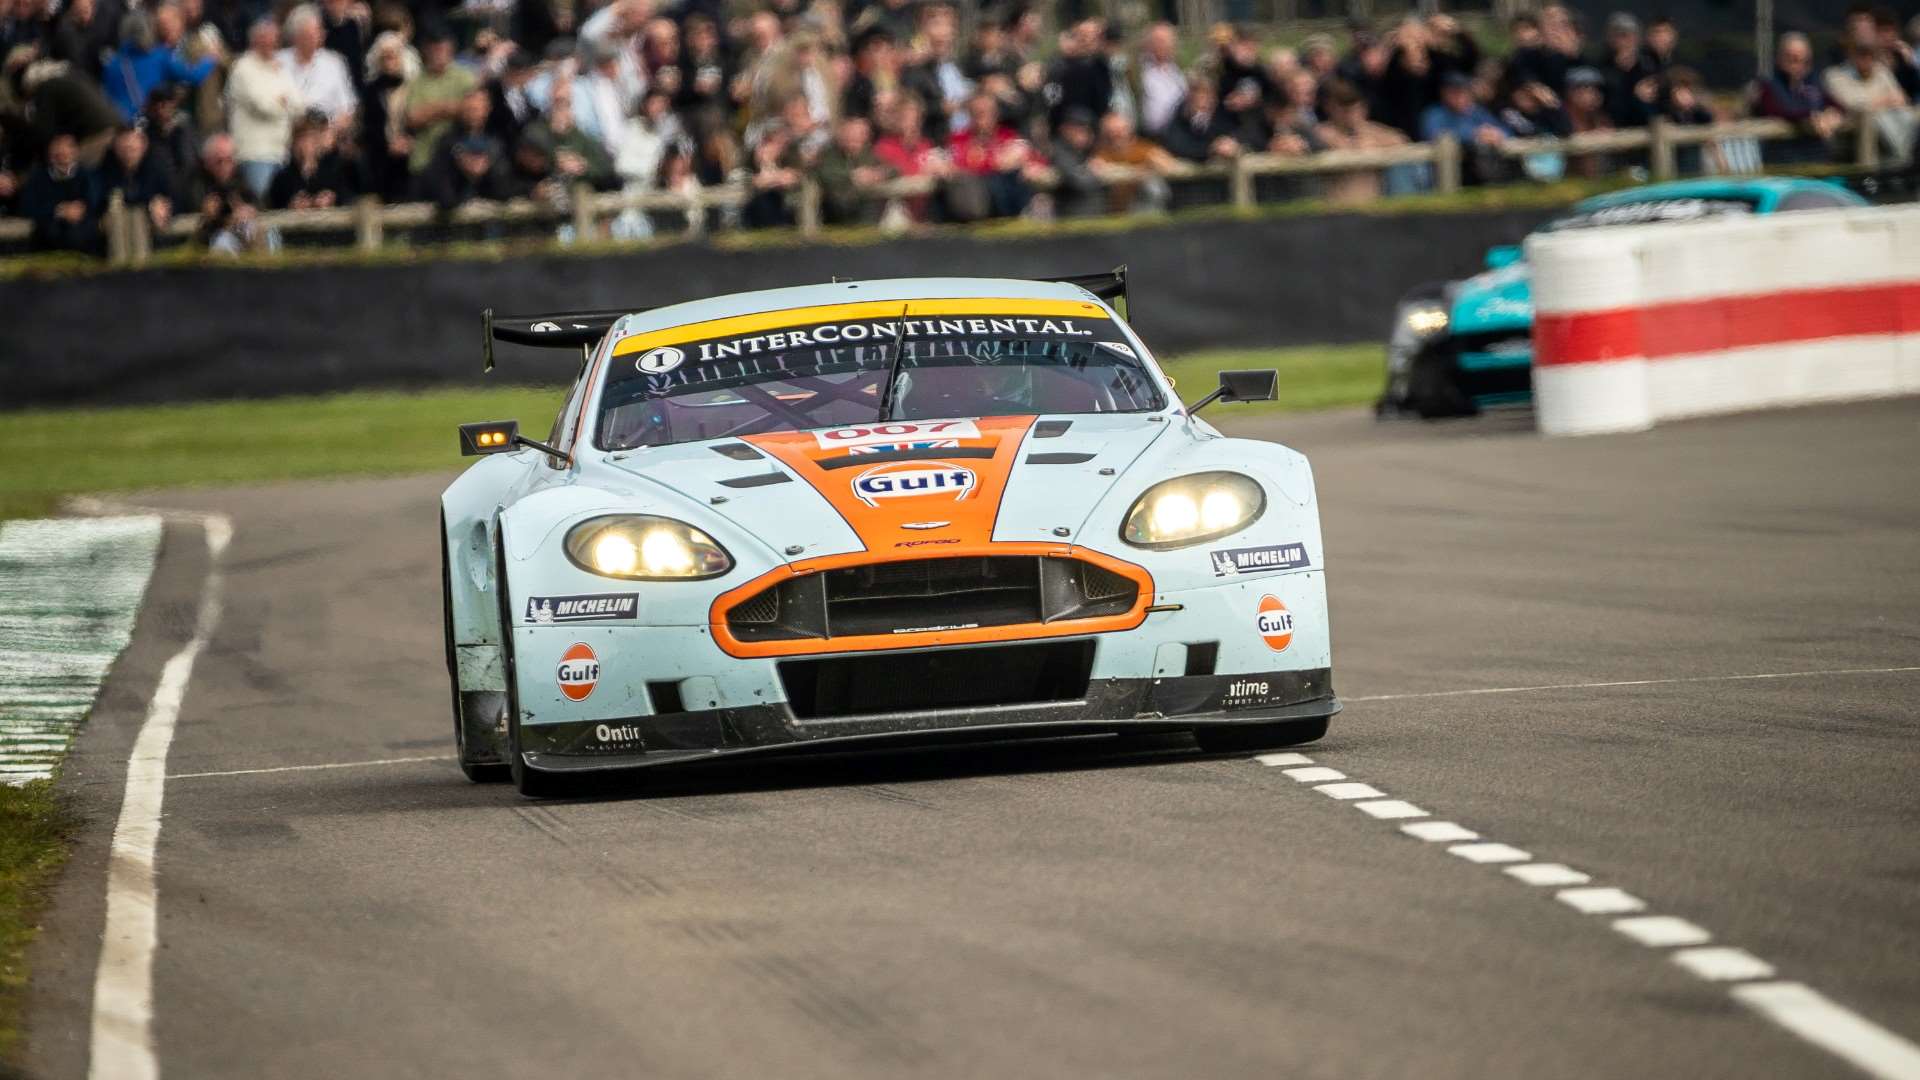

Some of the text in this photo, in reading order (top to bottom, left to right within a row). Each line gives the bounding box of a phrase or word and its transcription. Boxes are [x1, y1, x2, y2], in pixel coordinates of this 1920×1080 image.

[824, 421, 964, 440] 007
[859, 471, 968, 493] Gulf
[1237, 548, 1302, 567] MICHELIN
[555, 598, 633, 615] MICHELIN
[1258, 614, 1293, 632] Gulf
[557, 664, 599, 681] Gulf
